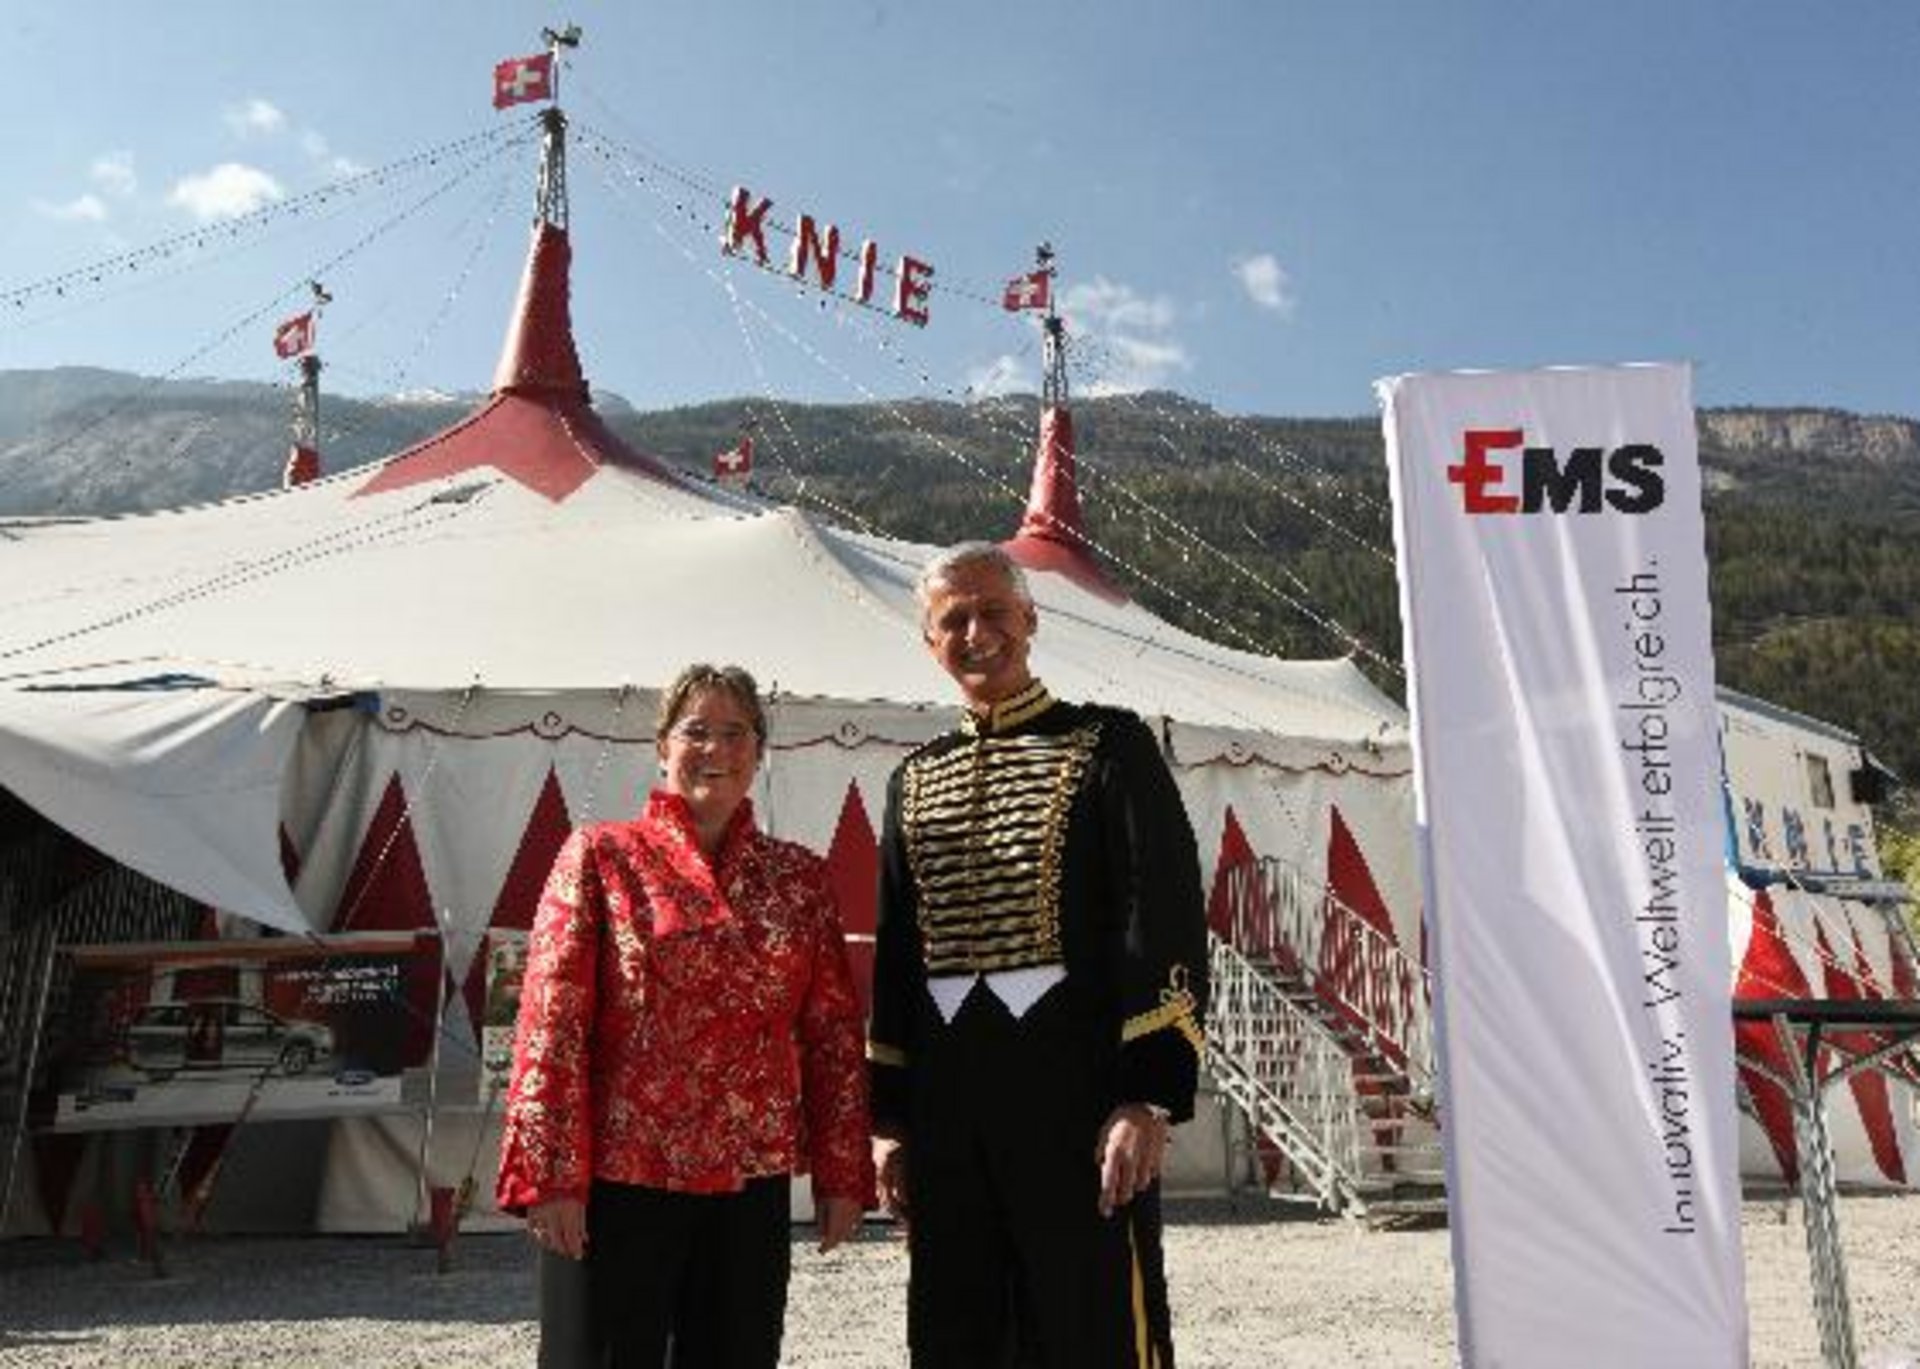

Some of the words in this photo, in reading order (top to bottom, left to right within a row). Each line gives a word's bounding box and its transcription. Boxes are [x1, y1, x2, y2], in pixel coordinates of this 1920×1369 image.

[727, 185, 935, 329] KNIE
[1447, 427, 1665, 515] EMS
[1614, 556, 1682, 796] erfolgreich.
[1635, 810, 1682, 1009] Weltweit
[1649, 1031, 1696, 1235] Innovativ.
